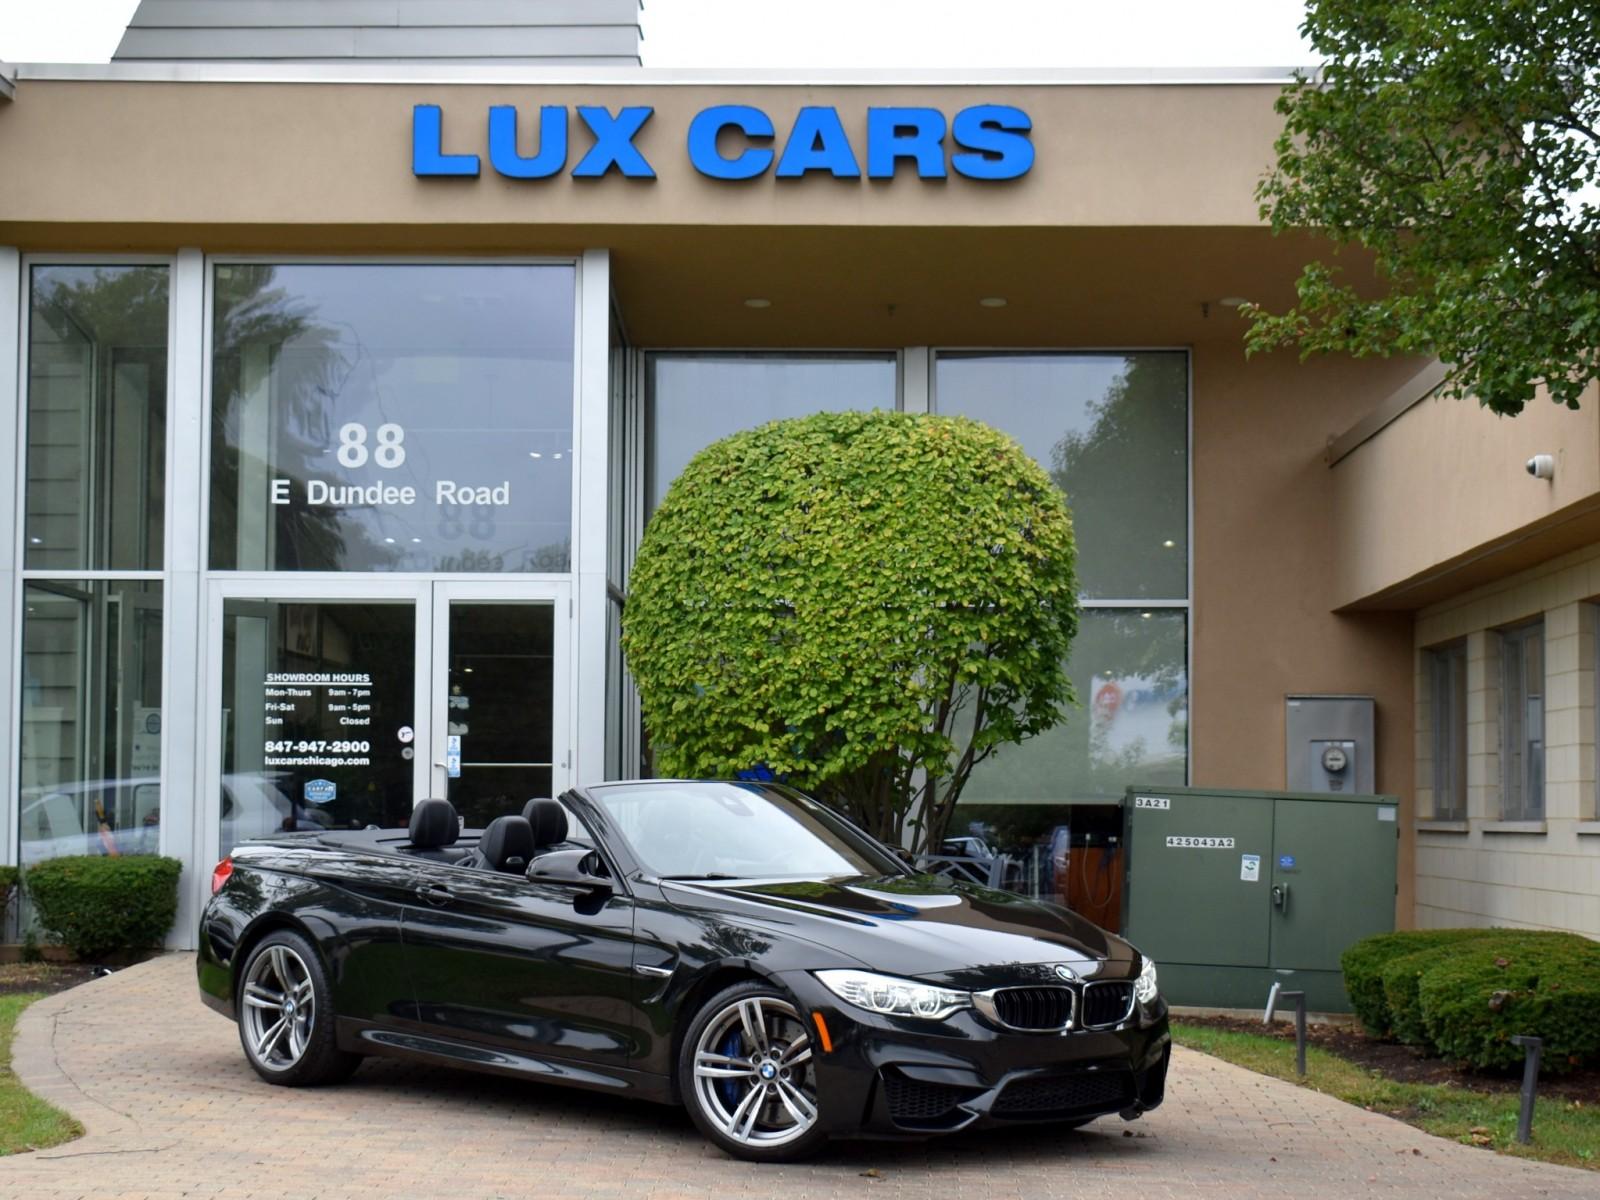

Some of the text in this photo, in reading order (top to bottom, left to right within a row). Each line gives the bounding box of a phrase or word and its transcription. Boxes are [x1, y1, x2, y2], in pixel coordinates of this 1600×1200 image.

[413, 104, 1036, 181] LUX CARS
[337, 423, 406, 469] 88
[271, 480, 510, 505] E Dundee Road
[266, 673, 370, 683] SHOWROOM HOURS
[265, 688, 312, 697] Mon-Thurs
[328, 688, 347, 697] 9am
[352, 688, 371, 698] 7pm
[265, 702, 295, 712] Fri-Sat
[328, 703, 347, 712] 9am
[352, 703, 371, 712] 5pm
[265, 716, 284, 725] Sun
[339, 716, 371, 725] Closed
[264, 740, 370, 753] 847-947-2900
[264, 755, 370, 767] luxcarschicago.com
[1137, 799, 1168, 808] 3A21
[1167, 838, 1233, 847] 425043A2
